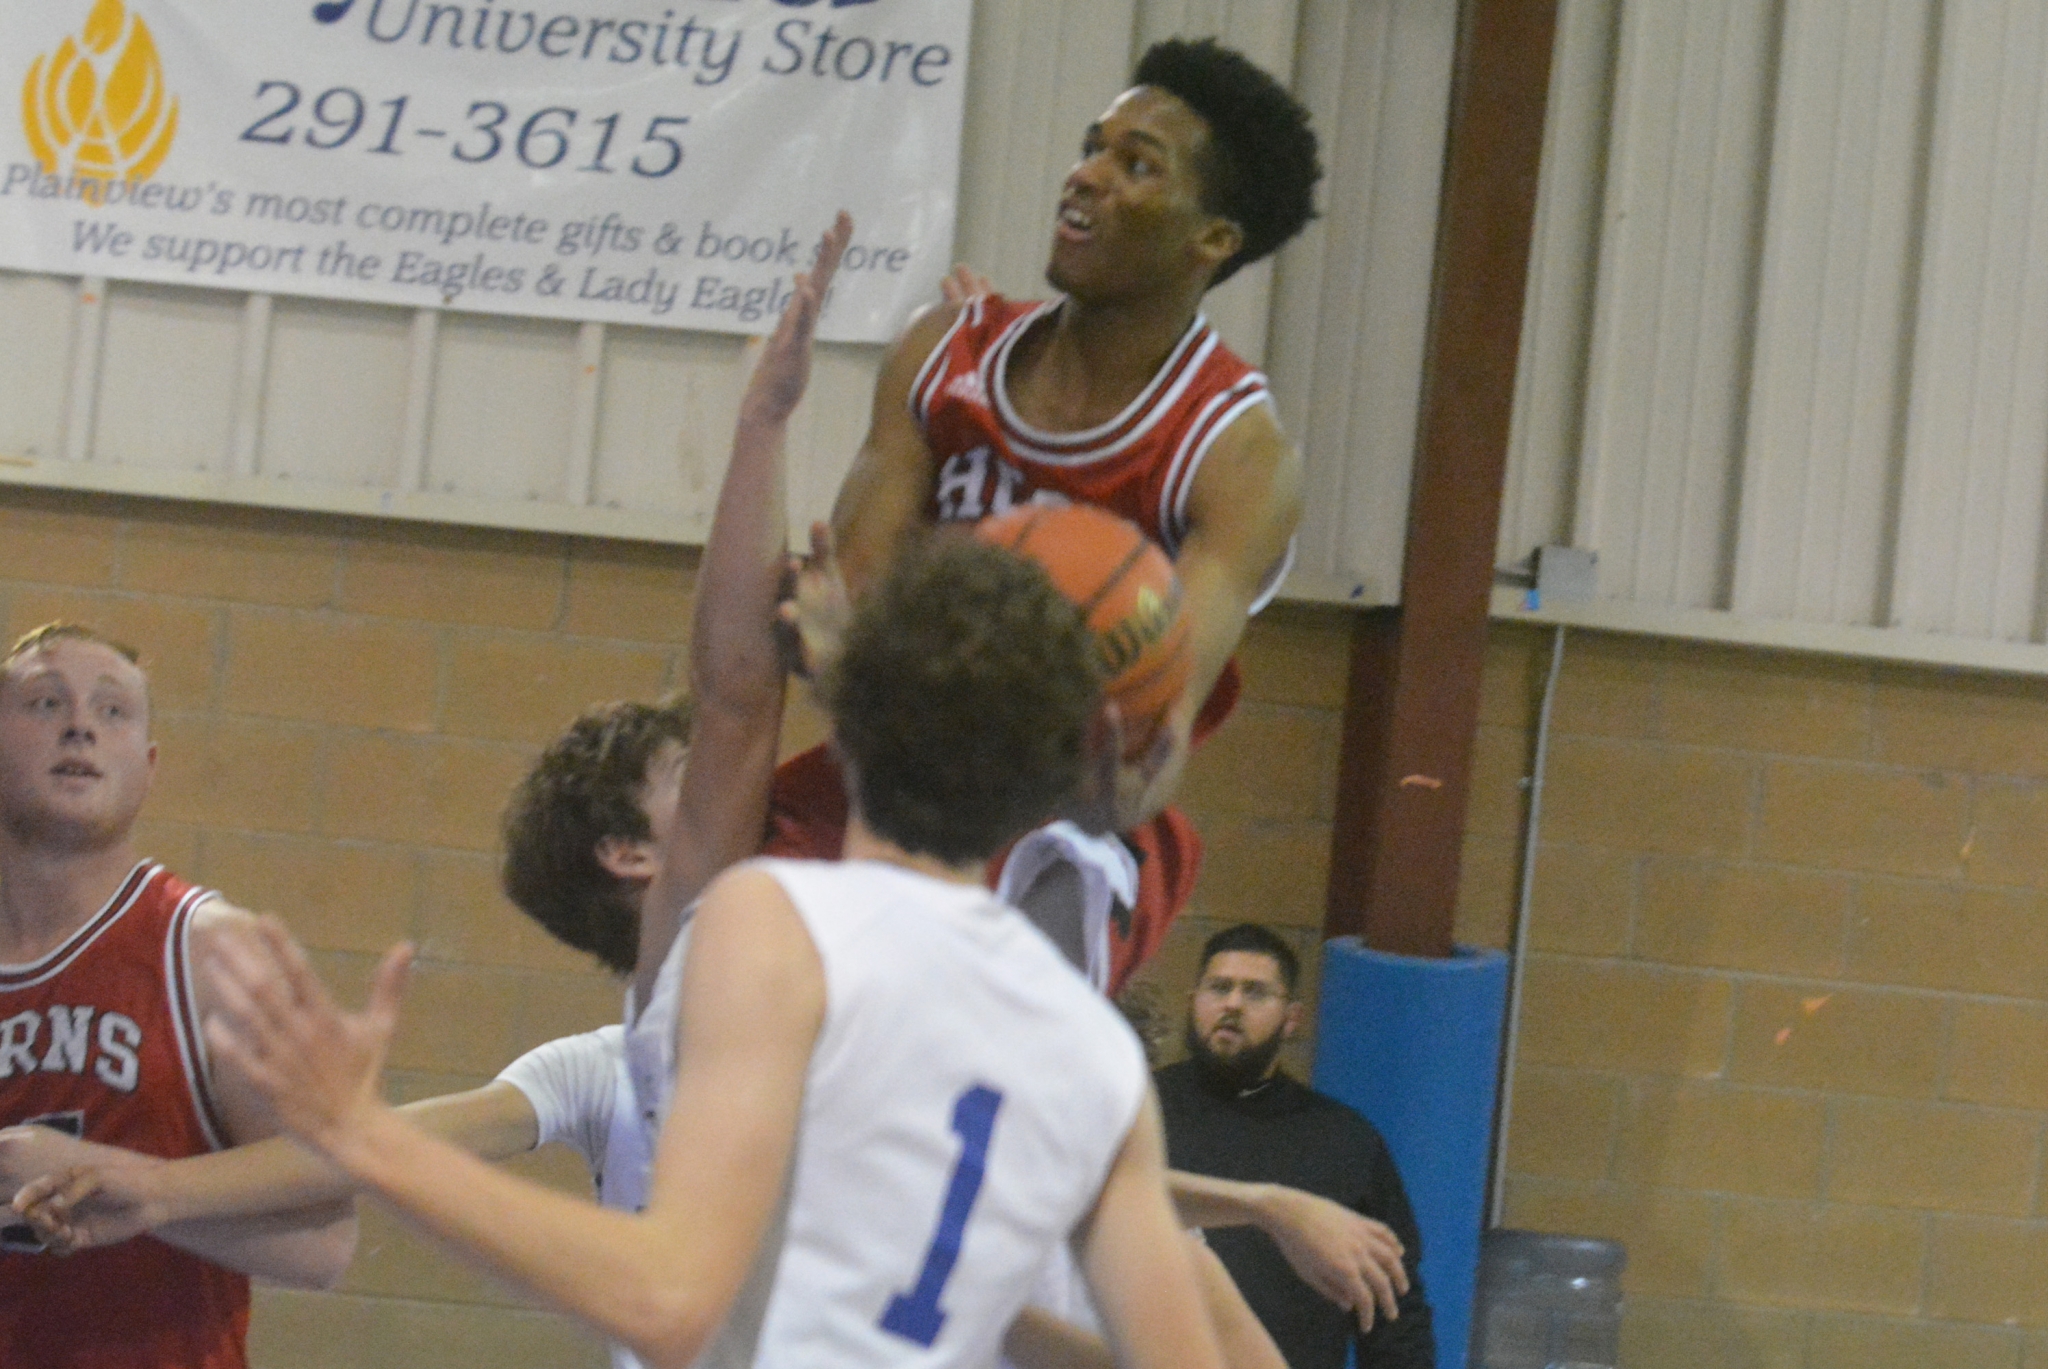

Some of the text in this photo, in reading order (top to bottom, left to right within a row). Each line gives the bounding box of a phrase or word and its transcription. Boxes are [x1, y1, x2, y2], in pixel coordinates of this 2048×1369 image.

[367, 0, 951, 87] University Store
[239, 81, 690, 178] 291-3615
[1, 162, 235, 216] Plainview's
[246, 189, 345, 226] most
[357, 201, 548, 244] complete
[557, 214, 645, 256] gifts
[655, 222, 683, 256] &
[695, 220, 799, 266] book
[73, 220, 134, 256] We
[142, 232, 307, 274] support
[318, 242, 380, 277] the
[391, 251, 524, 296] Eagles
[536, 264, 567, 297] &
[580, 267, 678, 315] Lady
[880, 1086, 1004, 1348] 1
